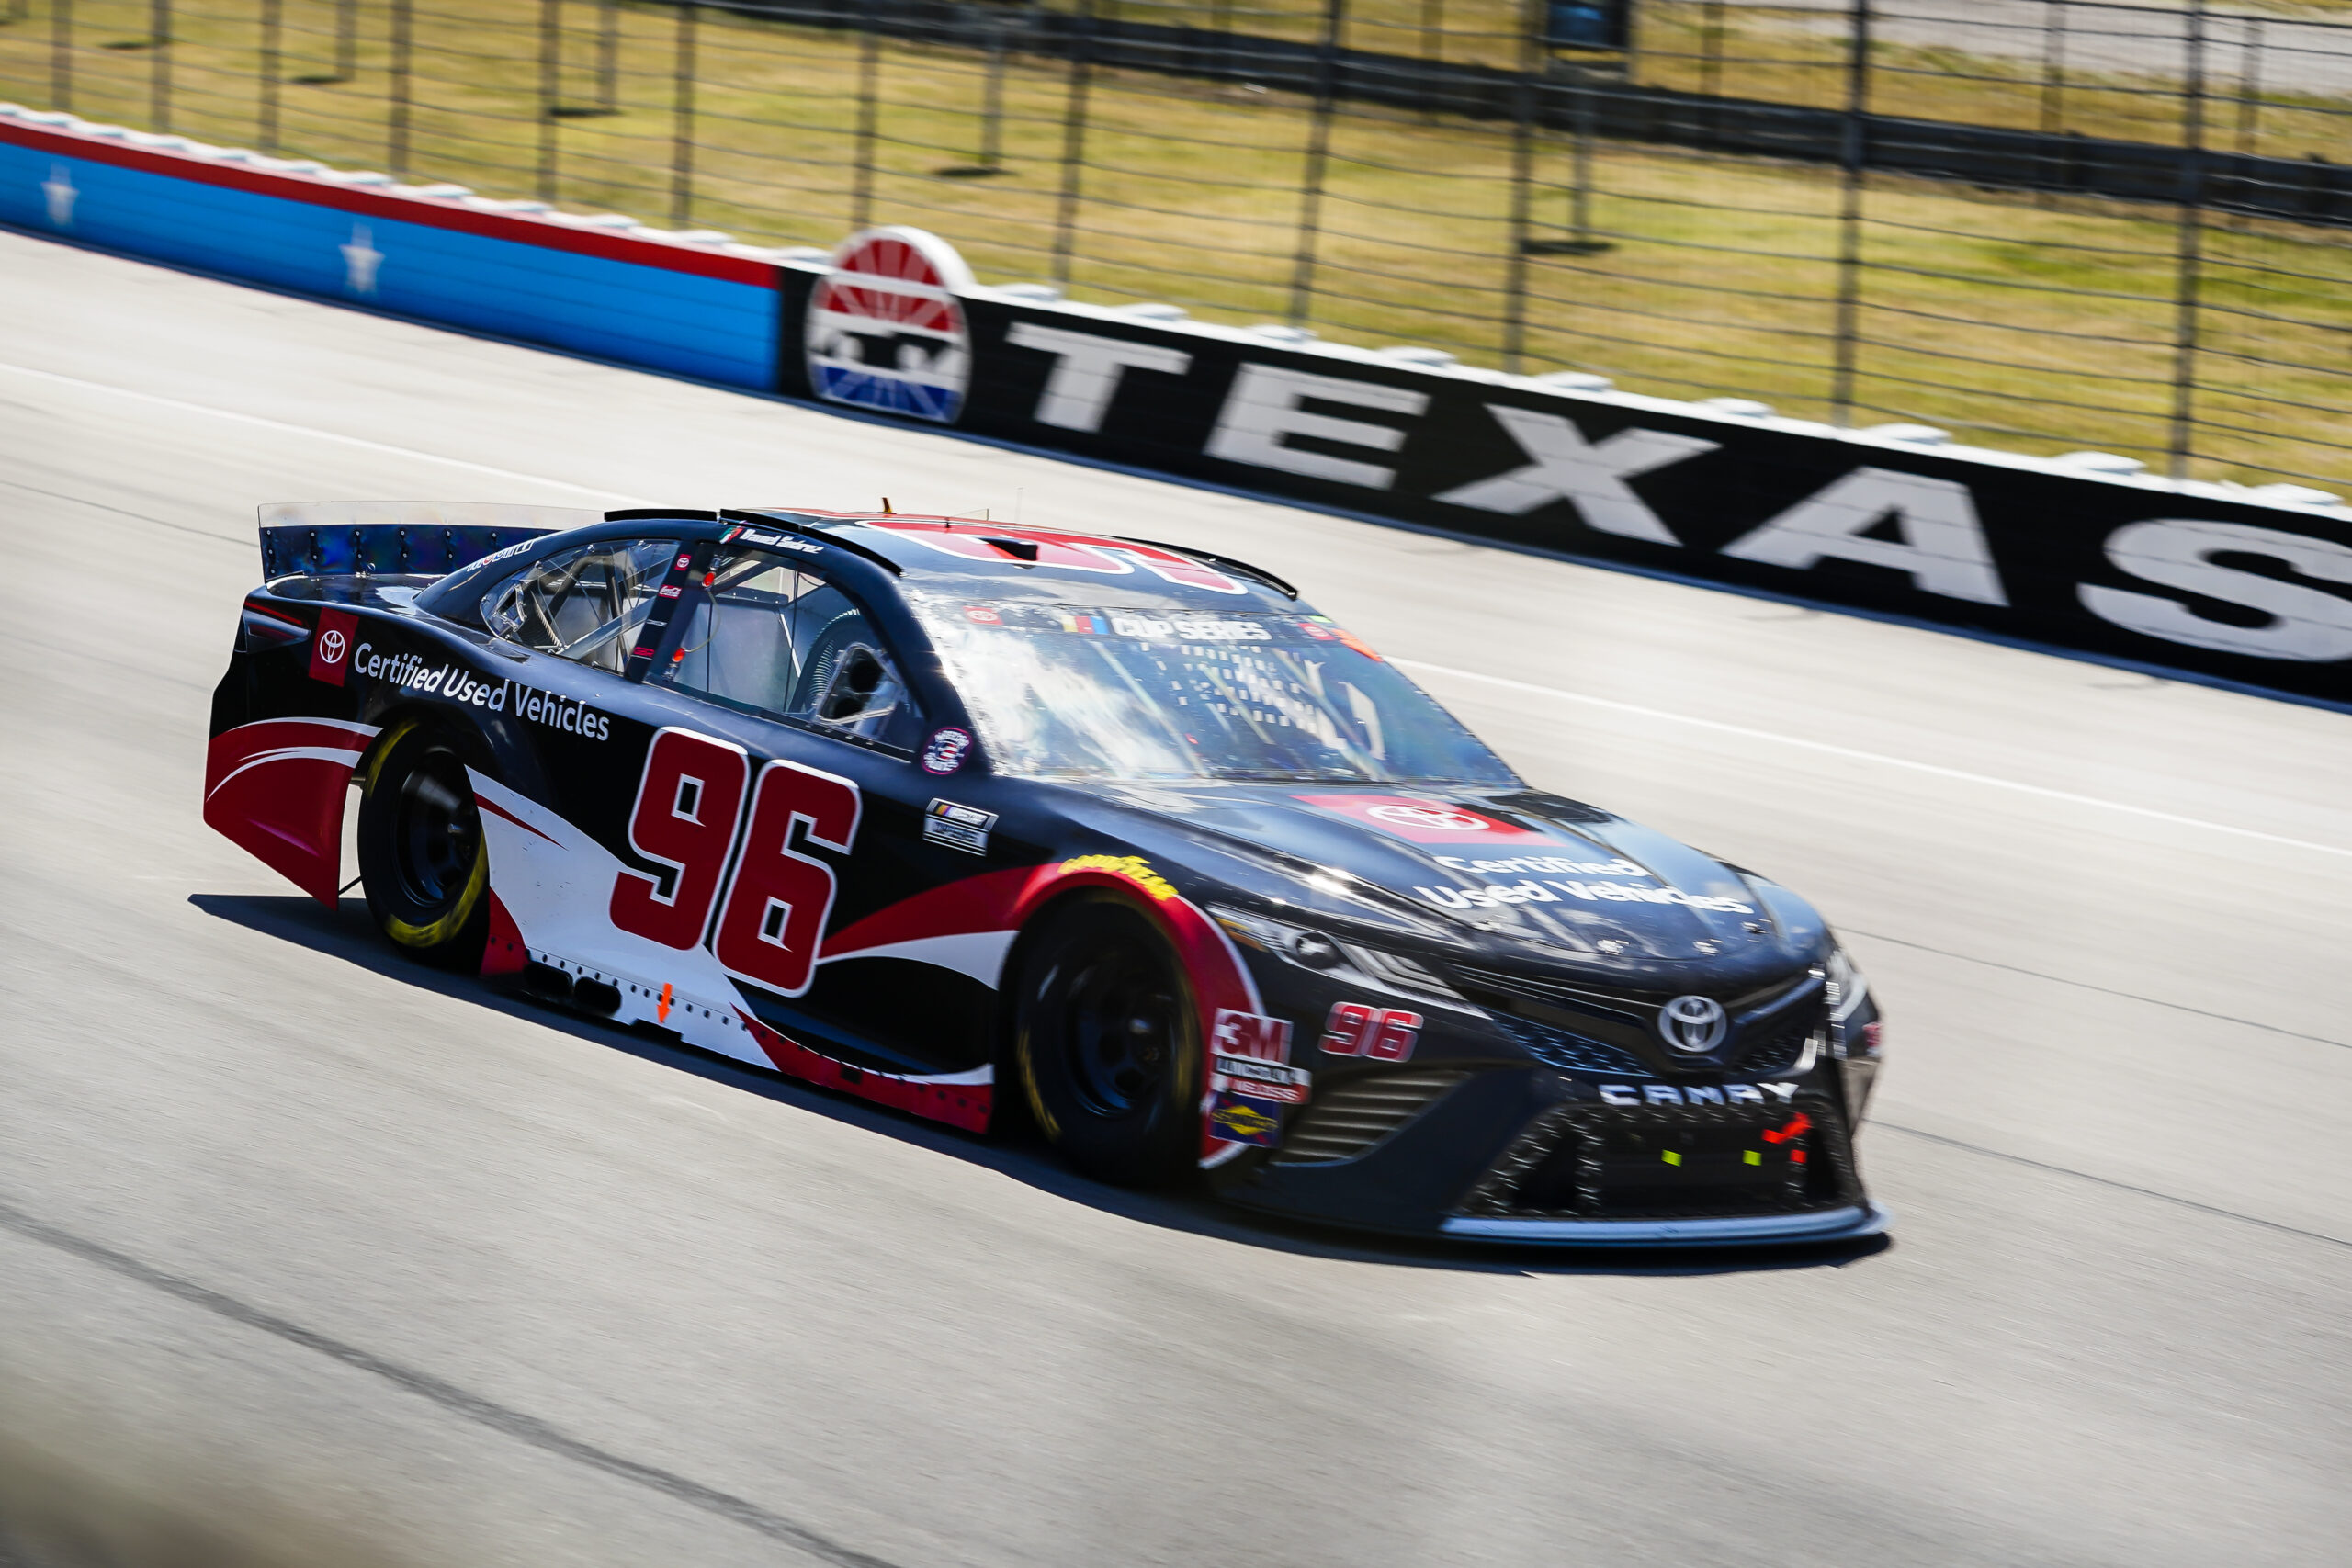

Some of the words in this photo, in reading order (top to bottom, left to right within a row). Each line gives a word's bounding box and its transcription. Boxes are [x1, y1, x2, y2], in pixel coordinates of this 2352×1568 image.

[1005, 321, 2352, 663] TEXAS
[1111, 617, 1175, 639] CUP
[1173, 620, 1273, 641] SERIES
[354, 642, 450, 694] Certified
[442, 668, 511, 712] Used
[515, 683, 610, 741] Vehicles
[608, 726, 863, 998] 96
[1433, 855, 1654, 878] Certified
[1412, 879, 1562, 909] Used
[1543, 879, 1754, 915] Vehicles
[1218, 1013, 1290, 1064] 3M
[1317, 1000, 1425, 1064] 96
[1598, 1082, 1800, 1107] CAMRY
